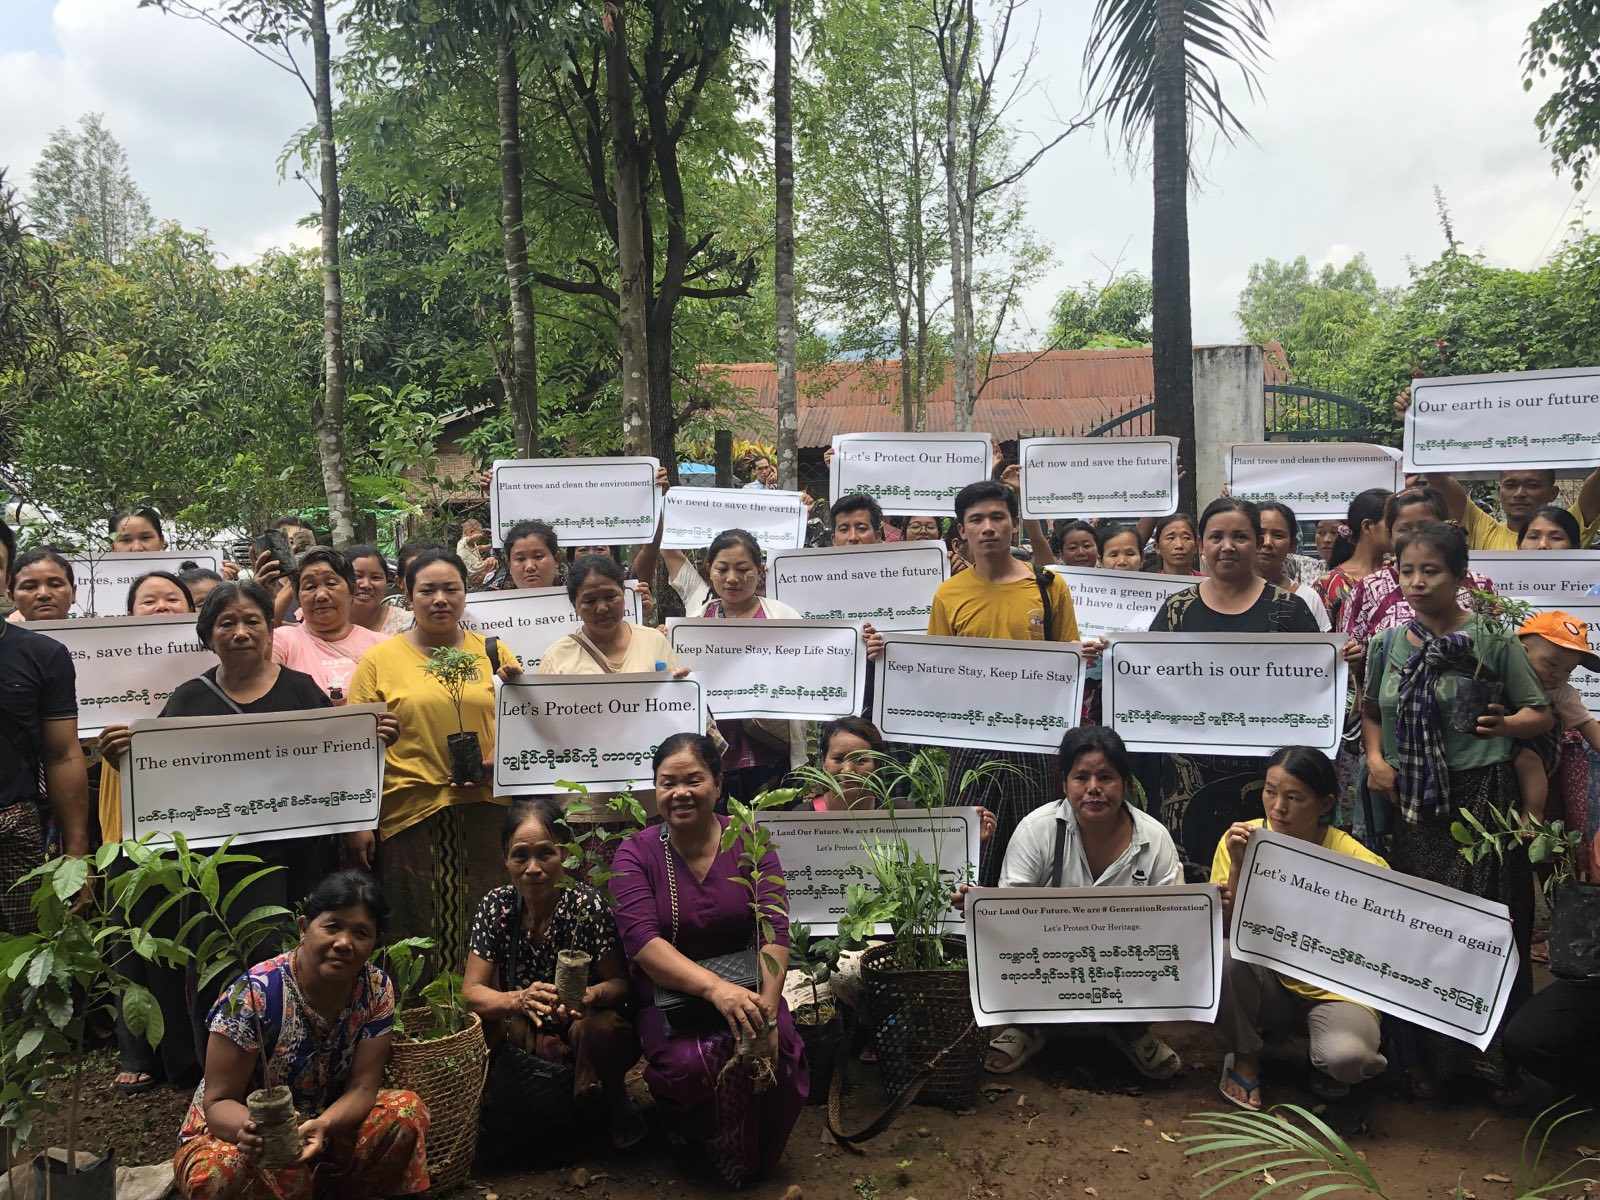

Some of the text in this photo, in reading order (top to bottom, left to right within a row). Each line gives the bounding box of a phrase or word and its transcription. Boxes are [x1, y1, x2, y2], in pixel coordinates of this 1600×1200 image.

[1419, 400, 1447, 412] Our
[1452, 398, 1492, 410] earth
[1498, 397, 1510, 408] is
[1515, 397, 1543, 407] our
[844, 451, 984, 463] Let's Protect Our Home.
[1028, 459, 1043, 468] Act
[1070, 458, 1088, 467] and
[1118, 457, 1133, 465] the
[1136, 456, 1170, 465] future.
[1234, 457, 1254, 465] Plant
[1281, 456, 1296, 464] and
[500, 482, 520, 490] Plant
[585, 480, 598, 488] the
[667, 496, 682, 504] We
[686, 499, 709, 507] need
[712, 500, 721, 508] to
[751, 504, 766, 512] the
[769, 505, 799, 514] earth.
[117, 576, 137, 584] sav
[778, 567, 941, 583] Act now and save the future.
[1080, 583, 1107, 594] have
[1120, 587, 1152, 599] green
[1518, 581, 1530, 590] is
[1533, 582, 1556, 591] our
[1086, 599, 1113, 608] have
[1126, 601, 1156, 613] clean
[458, 620, 477, 632] We
[481, 616, 513, 630] need
[518, 616, 531, 627] to
[535, 614, 565, 624] save
[96, 647, 132, 658] save
[138, 643, 163, 656] the
[676, 644, 854, 657] Keep Nature Stay, Keep Life Stay.
[888, 661, 1075, 684] Keep Nature Stay, Keep Life Stay.
[1117, 660, 1328, 678] Our earth is our future.
[503, 698, 696, 716] Let's Protect Our Home.
[136, 737, 376, 771] The environment is our Friend.
[1000, 907, 1020, 916] Land
[1022, 907, 1038, 915] Our
[1041, 907, 1071, 915] Future.
[1252, 862, 1506, 959] Let's Make the Earth green again.
[1044, 924, 1061, 933] Let's
[1063, 924, 1089, 932] Protect
[1091, 924, 1106, 932] Our
